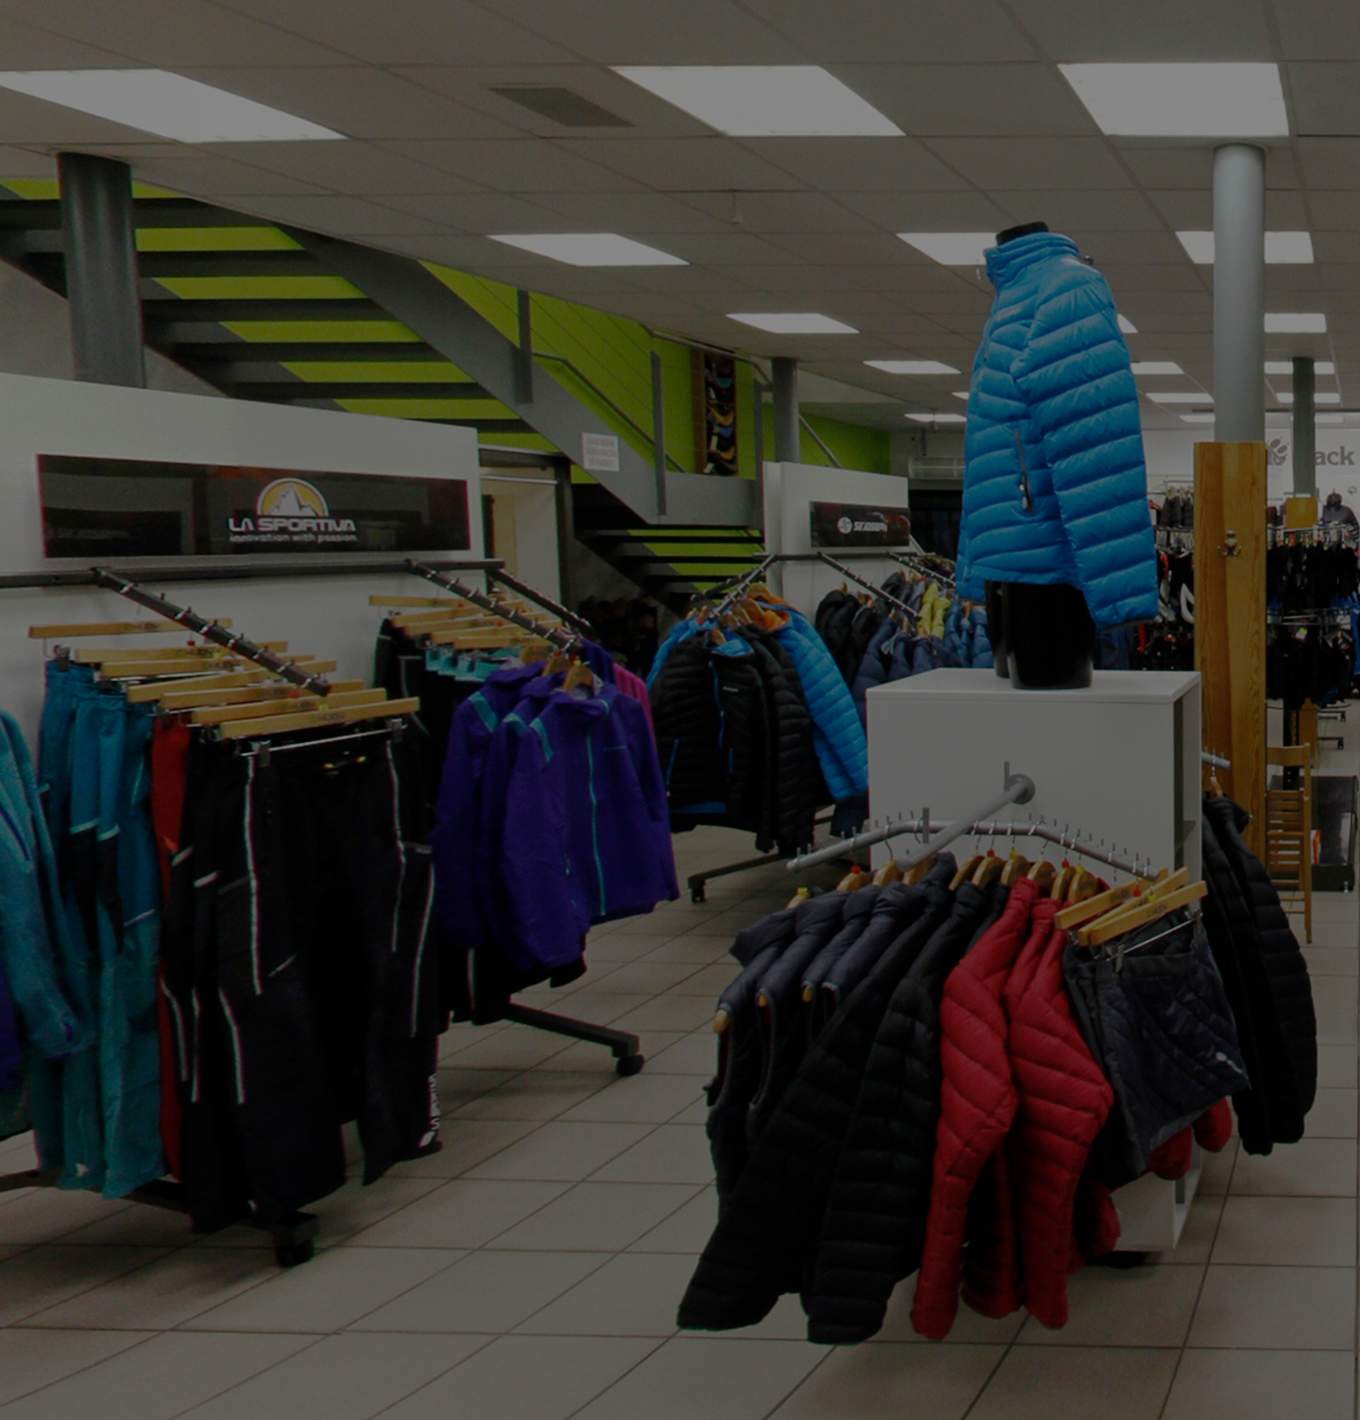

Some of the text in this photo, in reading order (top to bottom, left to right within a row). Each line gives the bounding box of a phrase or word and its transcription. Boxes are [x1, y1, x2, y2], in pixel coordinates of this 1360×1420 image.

[1313, 446, 1354, 466] ack
[228, 517, 356, 532] LA SPORTIVA
